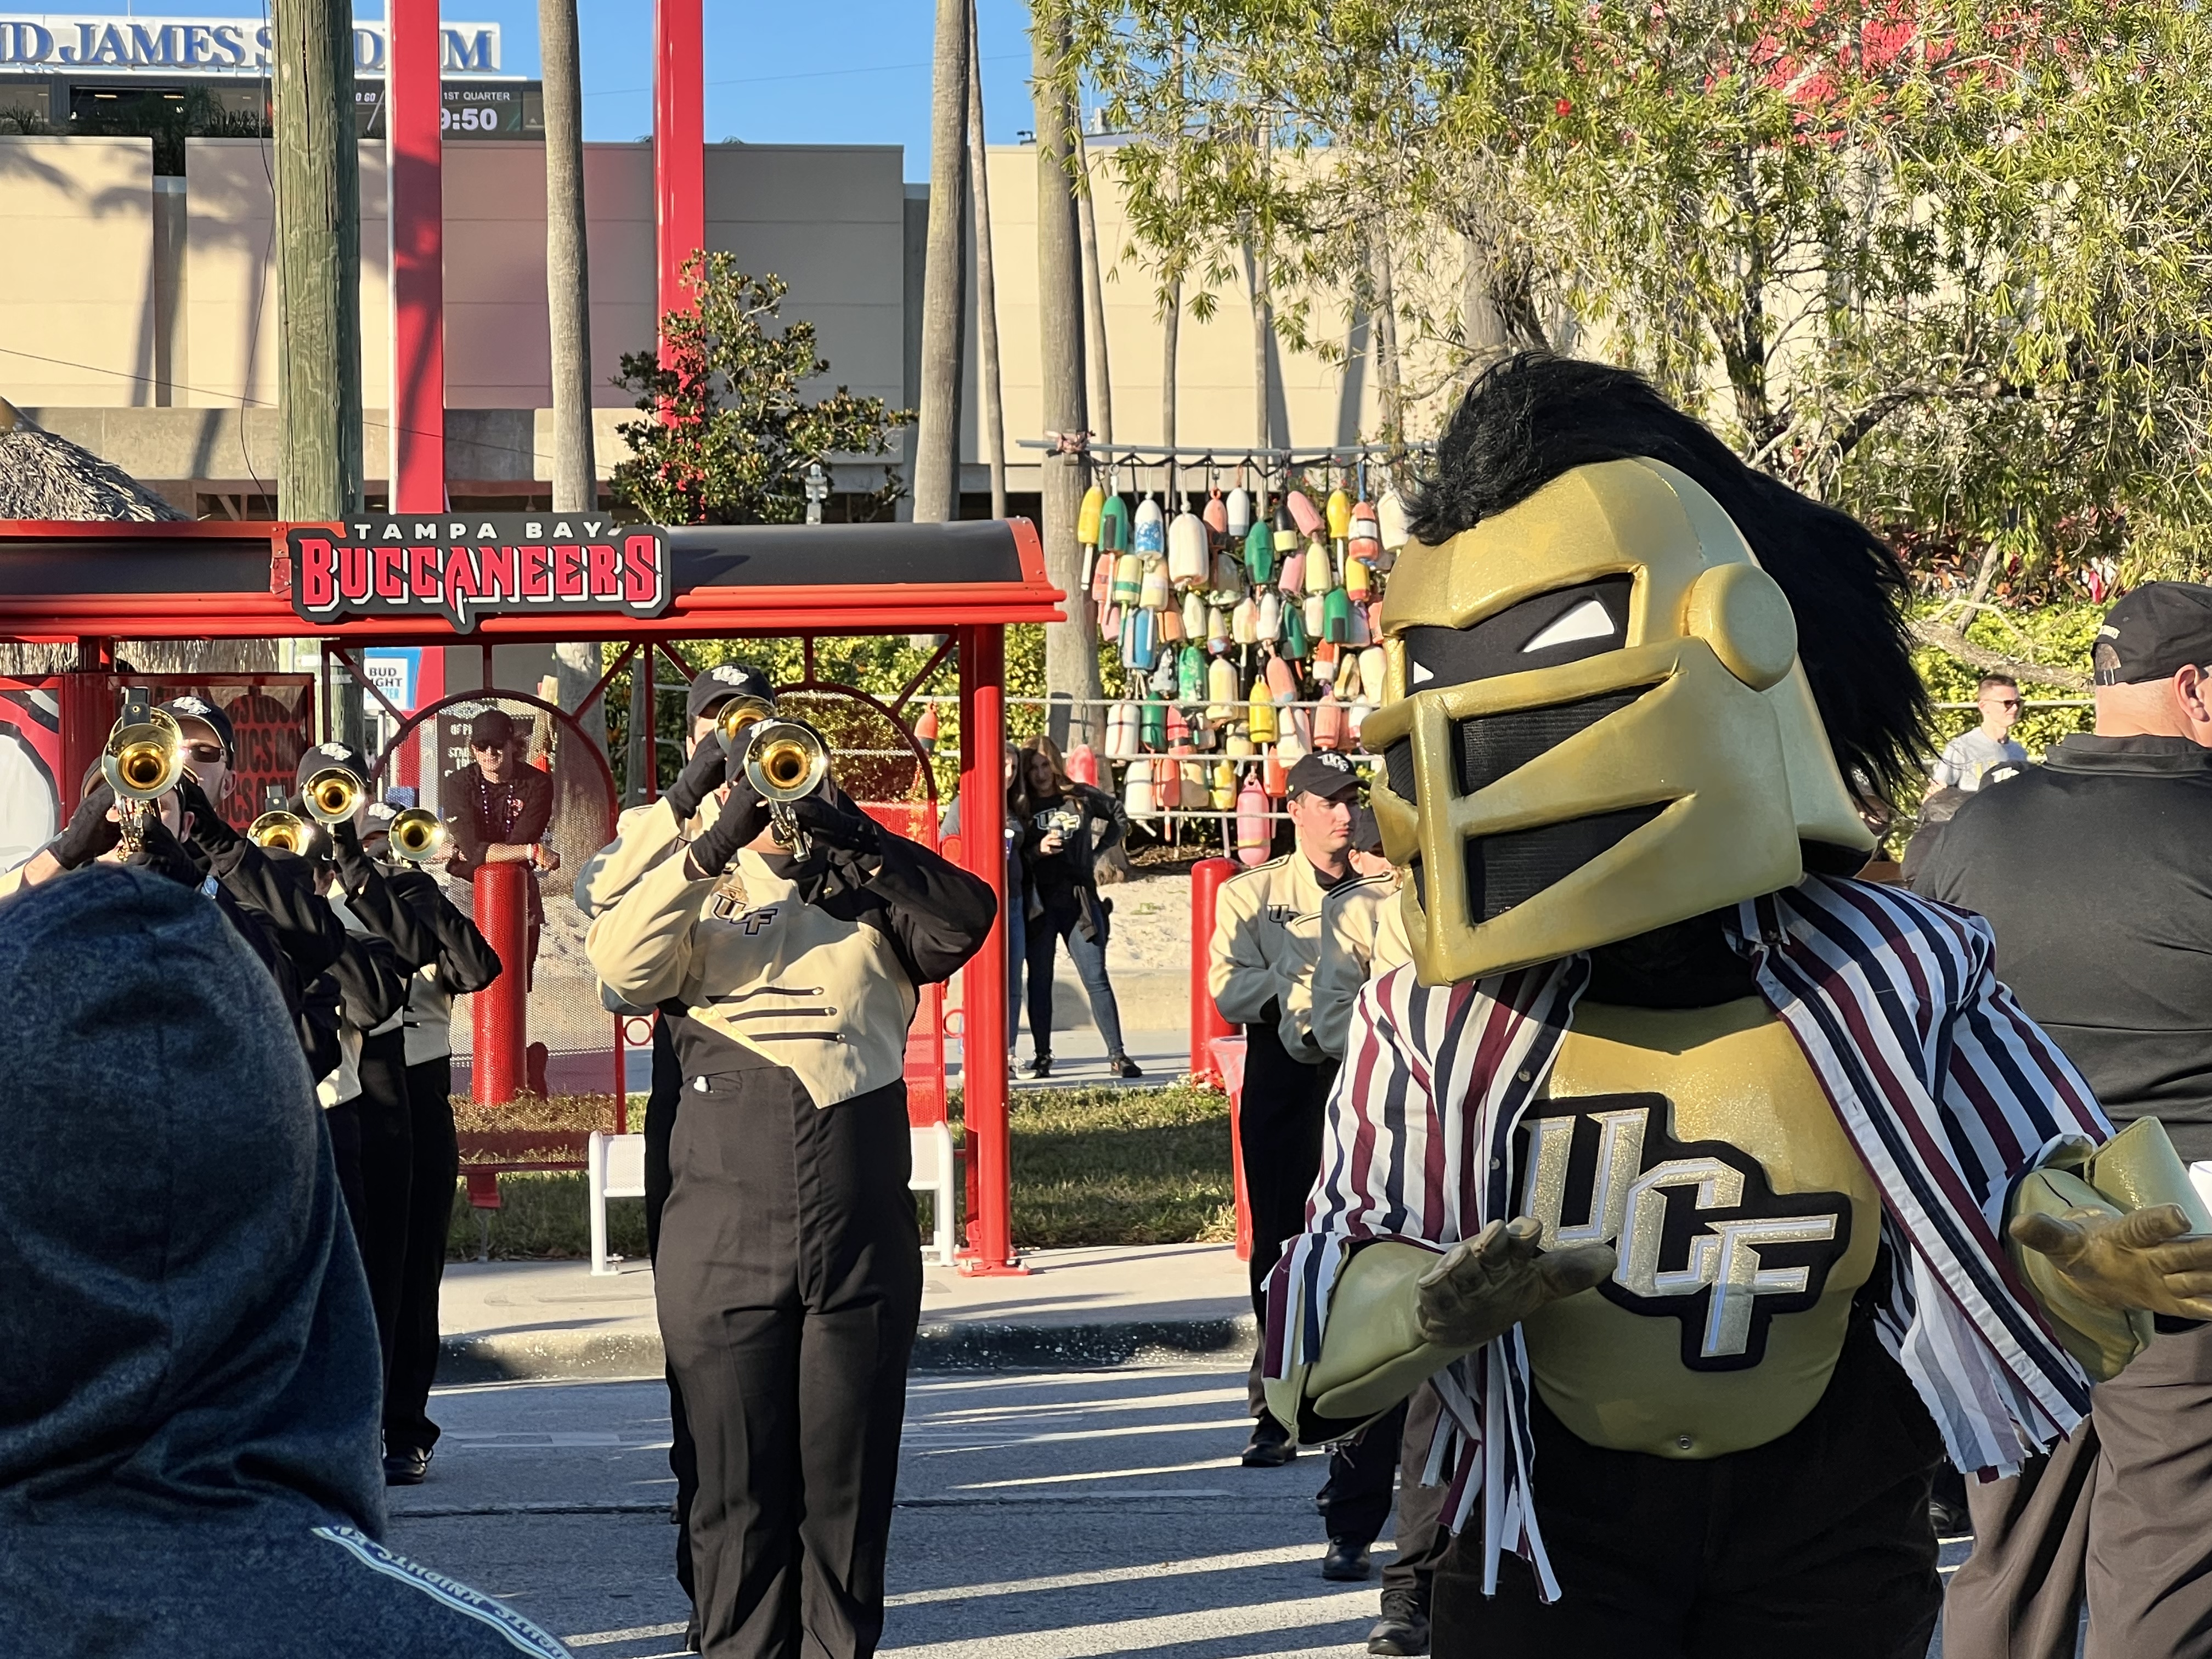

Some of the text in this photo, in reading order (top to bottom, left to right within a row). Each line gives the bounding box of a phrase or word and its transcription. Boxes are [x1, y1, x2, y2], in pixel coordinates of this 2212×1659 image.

[59, 22, 246, 67] JAMES
[444, 92, 510, 101] 1ST QUARTER
[354, 522, 602, 539] TAMPA BAY
[298, 534, 661, 624] BUCCANEERS
[369, 667, 397, 676] BUD
[370, 678, 403, 687] GHT
[1520, 1108, 1838, 1357] UCF
